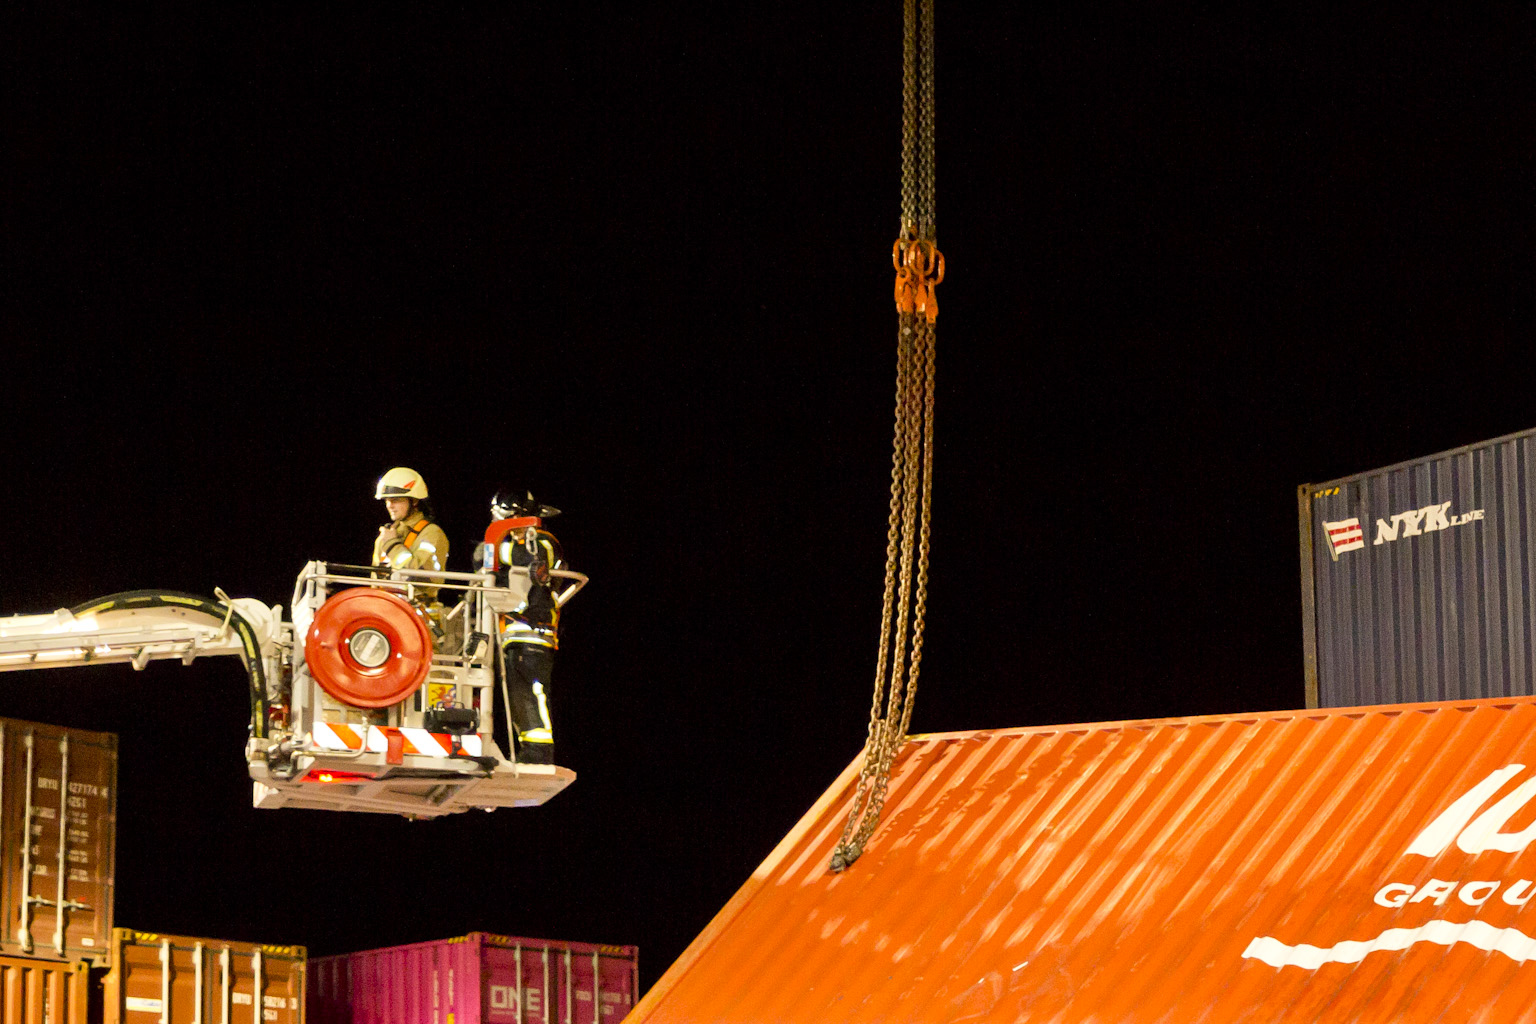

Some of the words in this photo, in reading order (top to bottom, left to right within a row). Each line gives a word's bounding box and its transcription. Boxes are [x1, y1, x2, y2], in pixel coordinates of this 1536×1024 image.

[1373, 501, 1452, 546] NYK
[1450, 509, 1485, 527] LINE
[491, 985, 541, 1011] ONE
